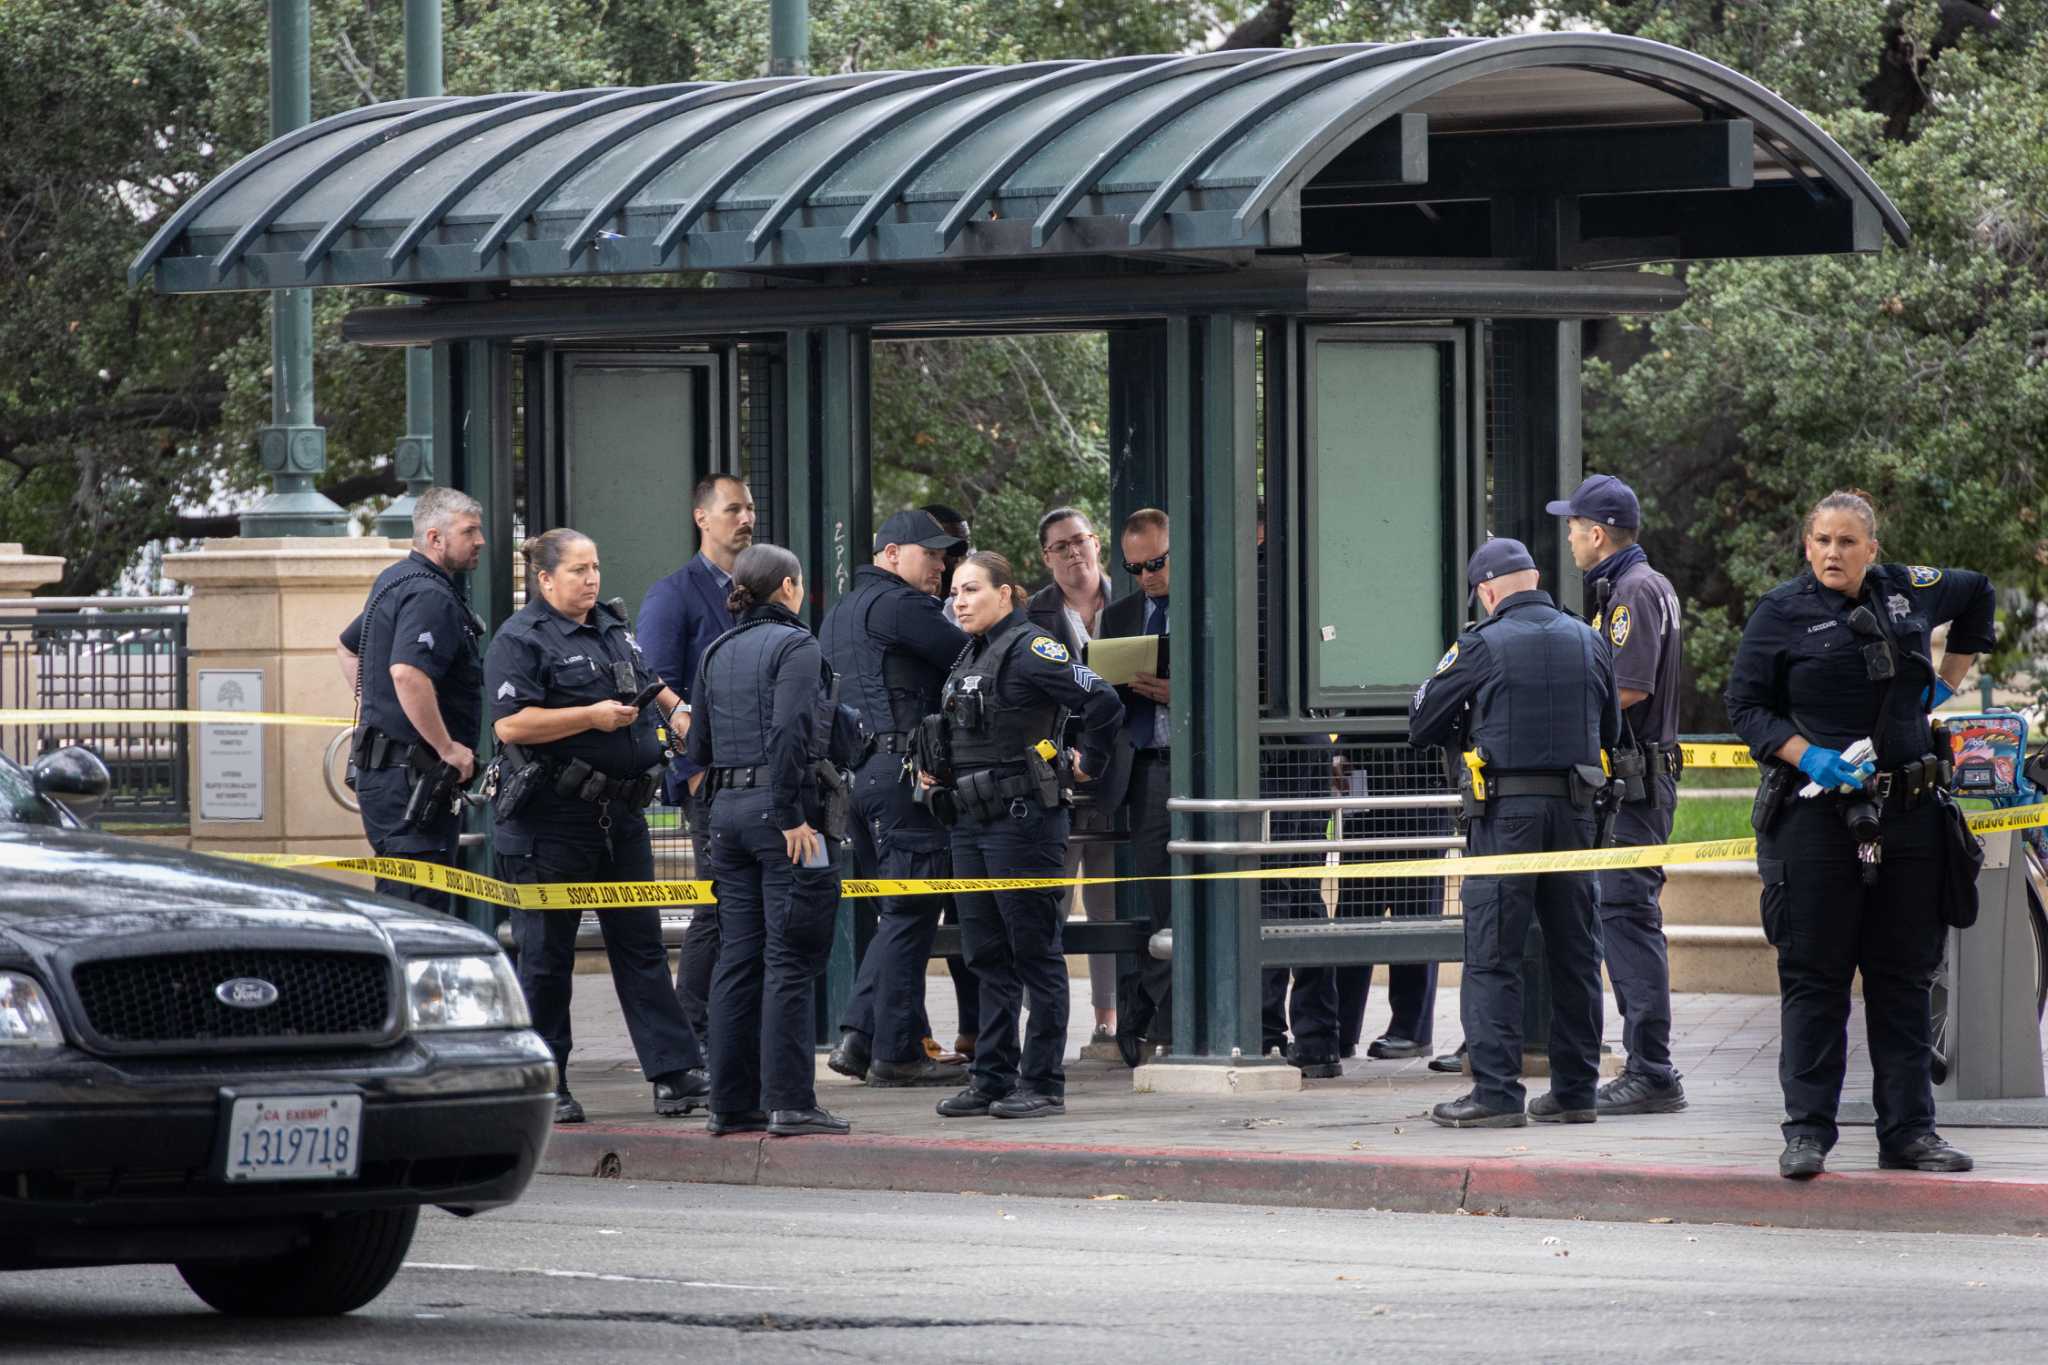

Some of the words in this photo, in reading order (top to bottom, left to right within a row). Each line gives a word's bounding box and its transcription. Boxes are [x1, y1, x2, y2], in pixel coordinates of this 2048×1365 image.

[567, 887, 599, 905] CROSS
[601, 886, 620, 904] NOT
[619, 886, 633, 903] DO
[635, 885, 666, 902] SCENE
[669, 884, 699, 901] CRIME
[233, 984, 263, 1000] Ford
[263, 1110, 279, 1121] CA
[286, 1109, 328, 1121] EXEMPT
[238, 1126, 350, 1166] 1319718
